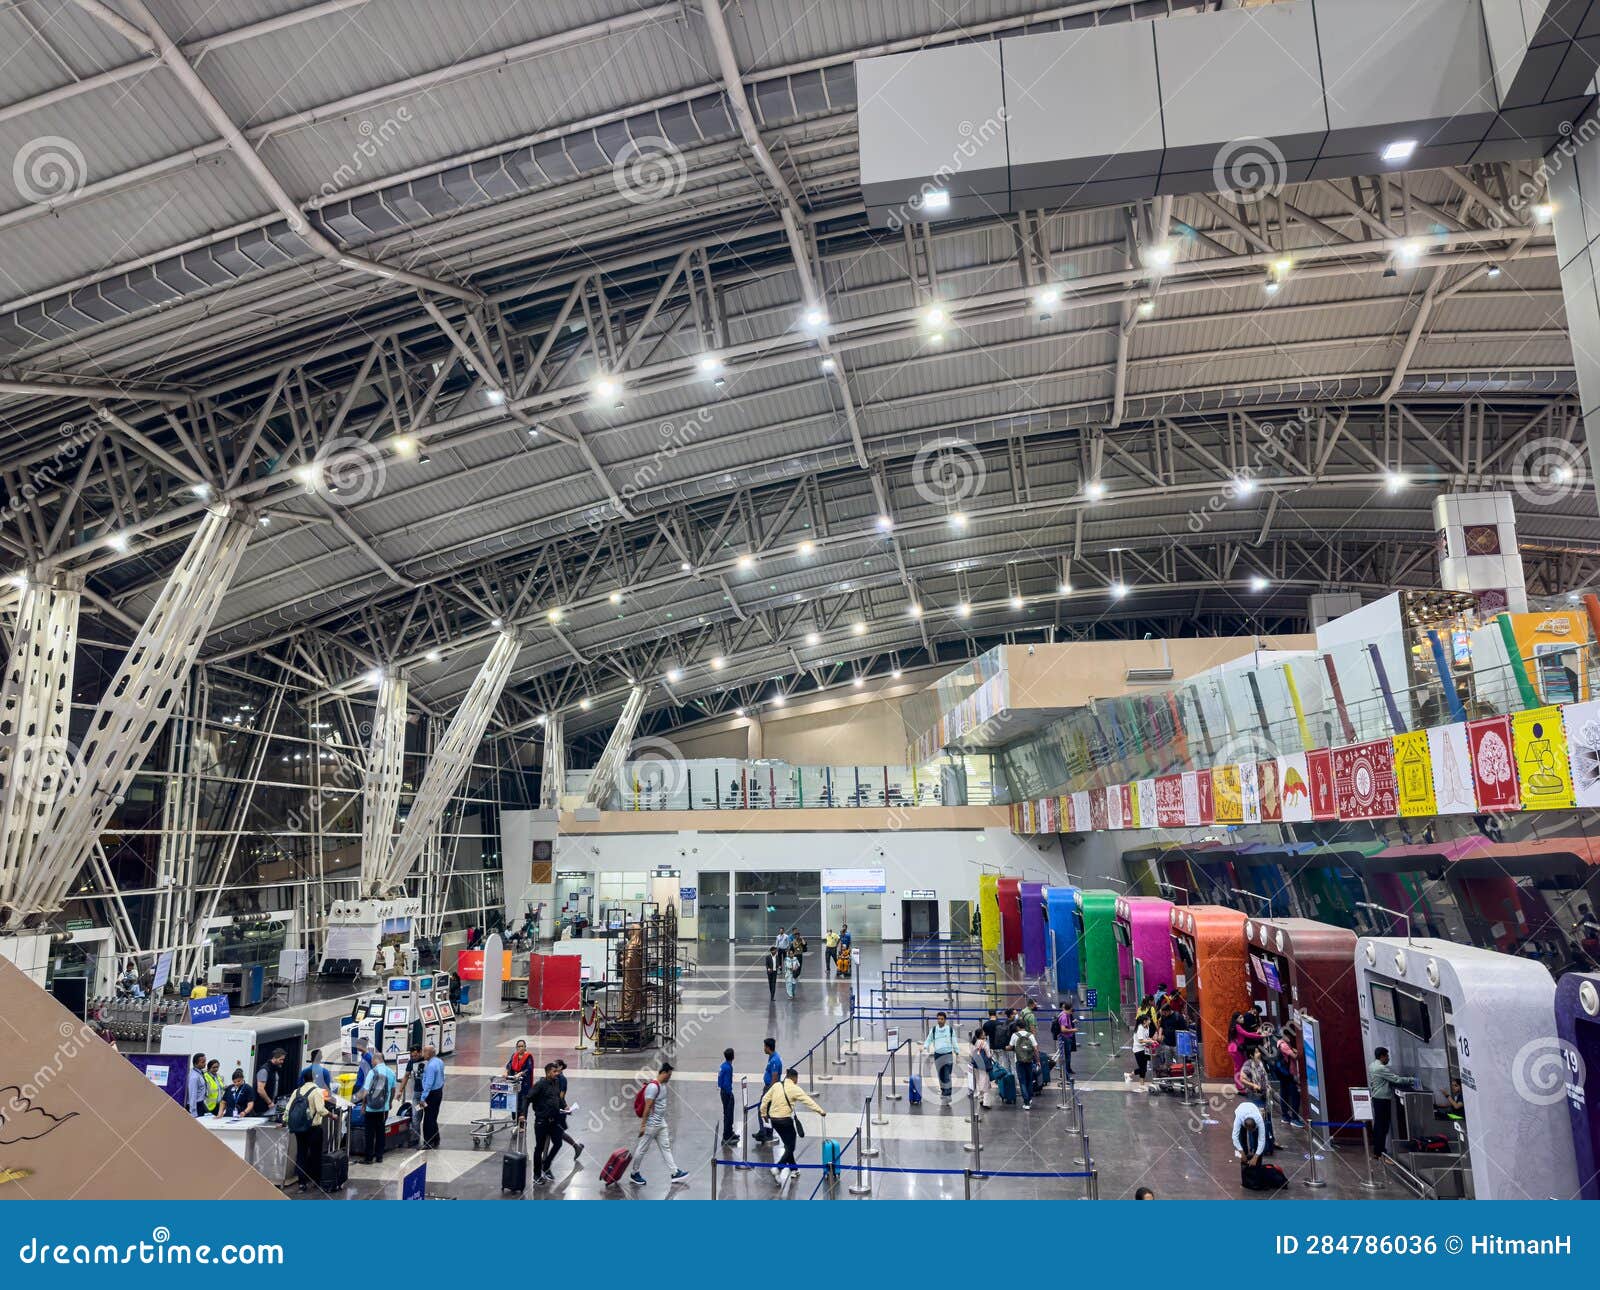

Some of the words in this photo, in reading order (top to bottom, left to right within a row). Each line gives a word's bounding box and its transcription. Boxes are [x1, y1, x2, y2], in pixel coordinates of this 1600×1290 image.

[193, 1003, 218, 1015] x-ray
[1458, 1036, 1470, 1057] 18
[1563, 1048, 1578, 1073] 19
